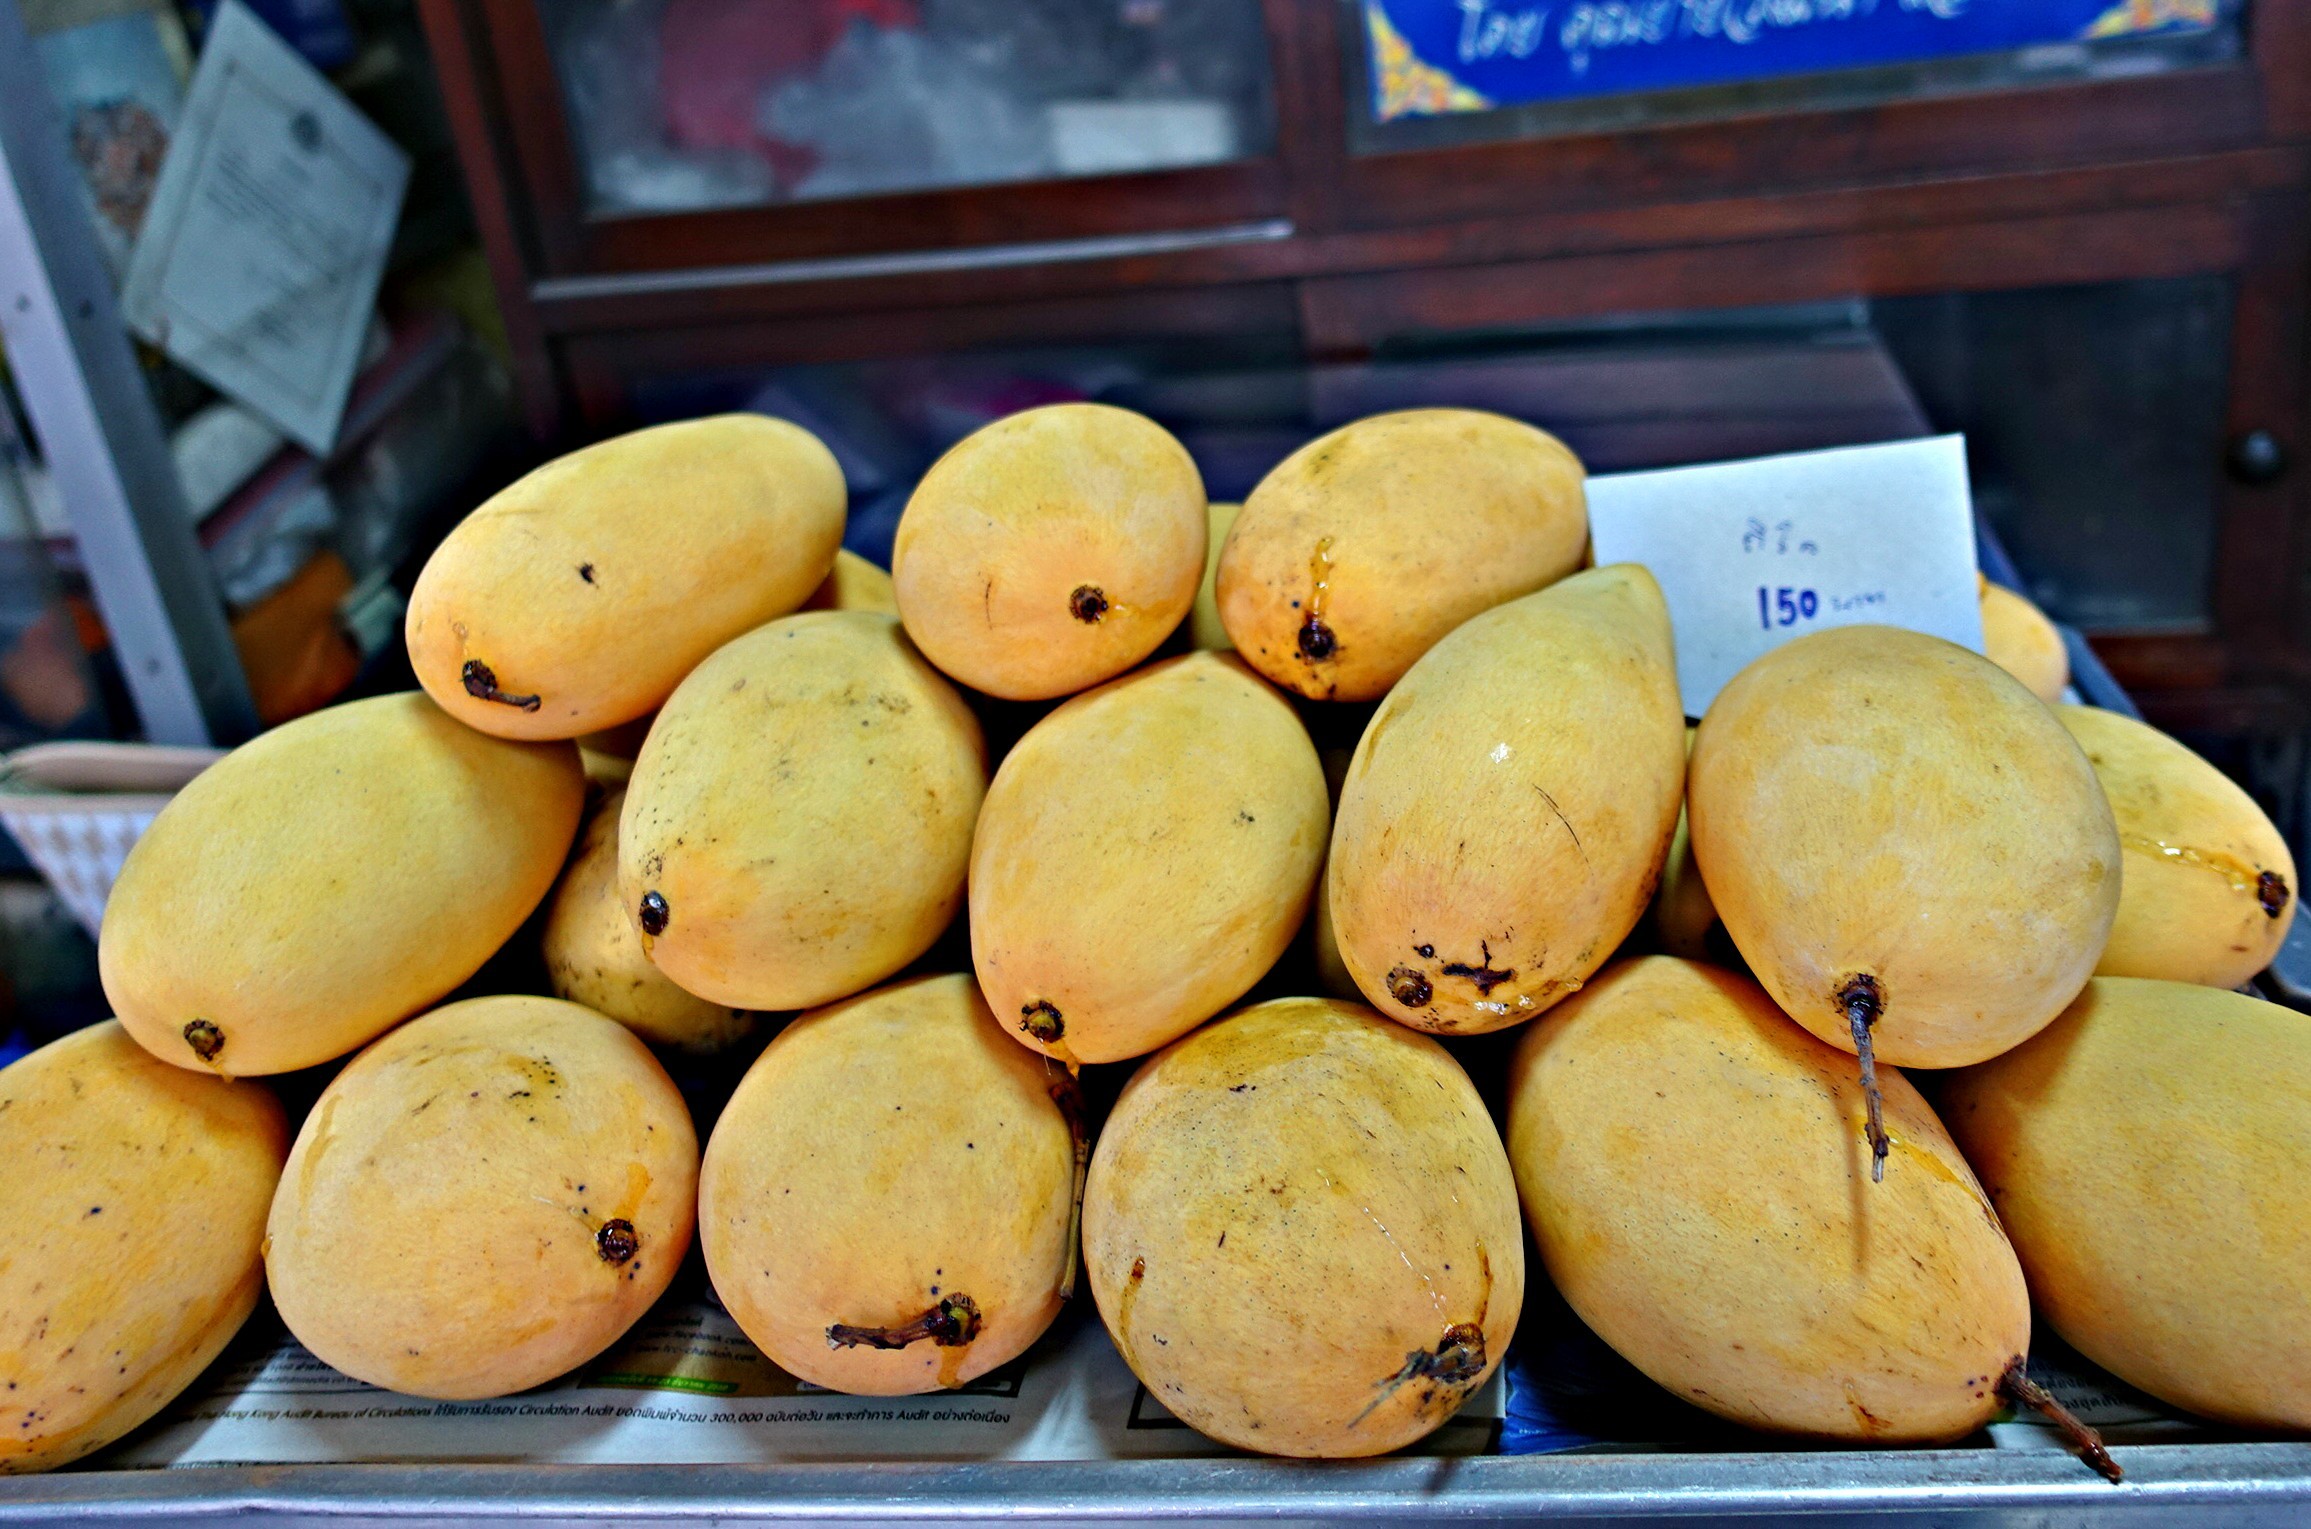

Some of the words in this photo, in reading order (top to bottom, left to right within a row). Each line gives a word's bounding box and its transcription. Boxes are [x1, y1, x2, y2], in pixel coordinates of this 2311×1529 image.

[1757, 585, 1819, 631] 150
[368, 1405, 433, 1418] Circulations
[519, 1403, 580, 1416] Circulation
[581, 1404, 616, 1417] Audit
[709, 1411, 764, 1424] 300,000
[896, 1408, 931, 1421] Audit
